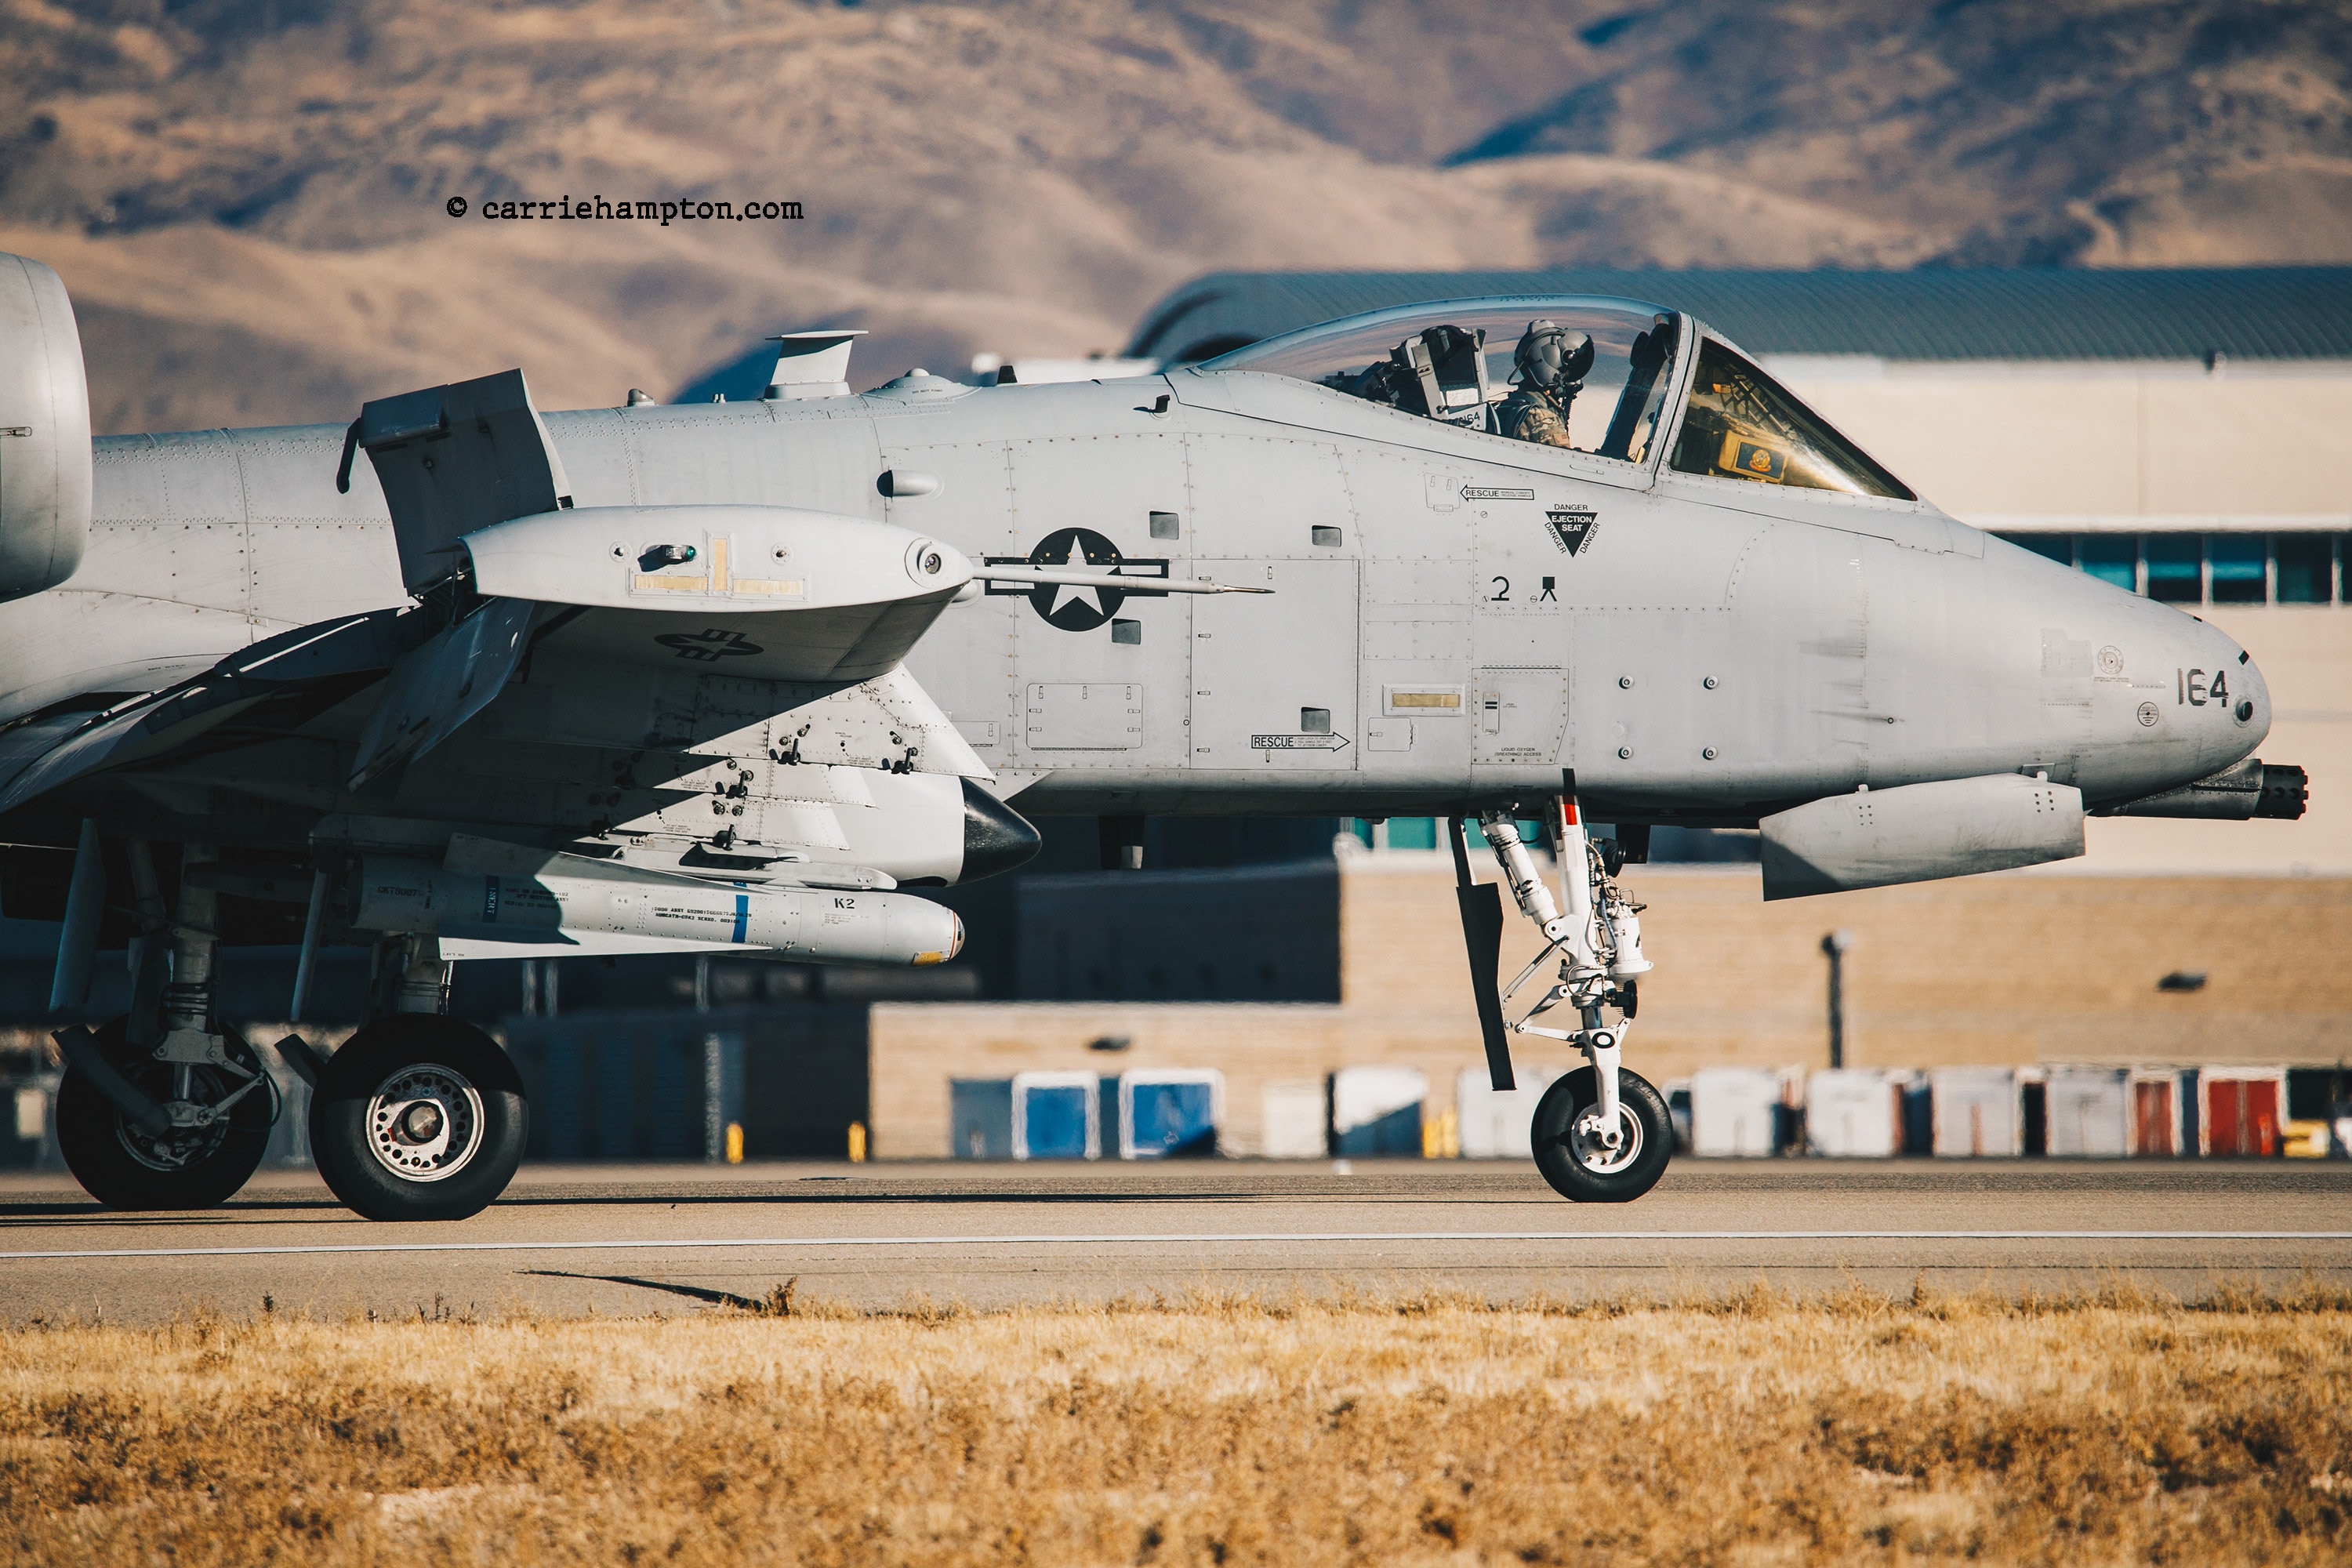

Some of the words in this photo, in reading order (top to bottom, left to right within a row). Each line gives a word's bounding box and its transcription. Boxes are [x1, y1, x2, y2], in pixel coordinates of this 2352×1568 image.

[1544, 522, 1567, 554] DANGER
[1579, 522, 1600, 554] DANGER
[2177, 668, 2229, 707] 164
[1254, 737, 1294, 747] RESCUE
[487, 887, 496, 915] INERT
[834, 898, 855, 909] K2
